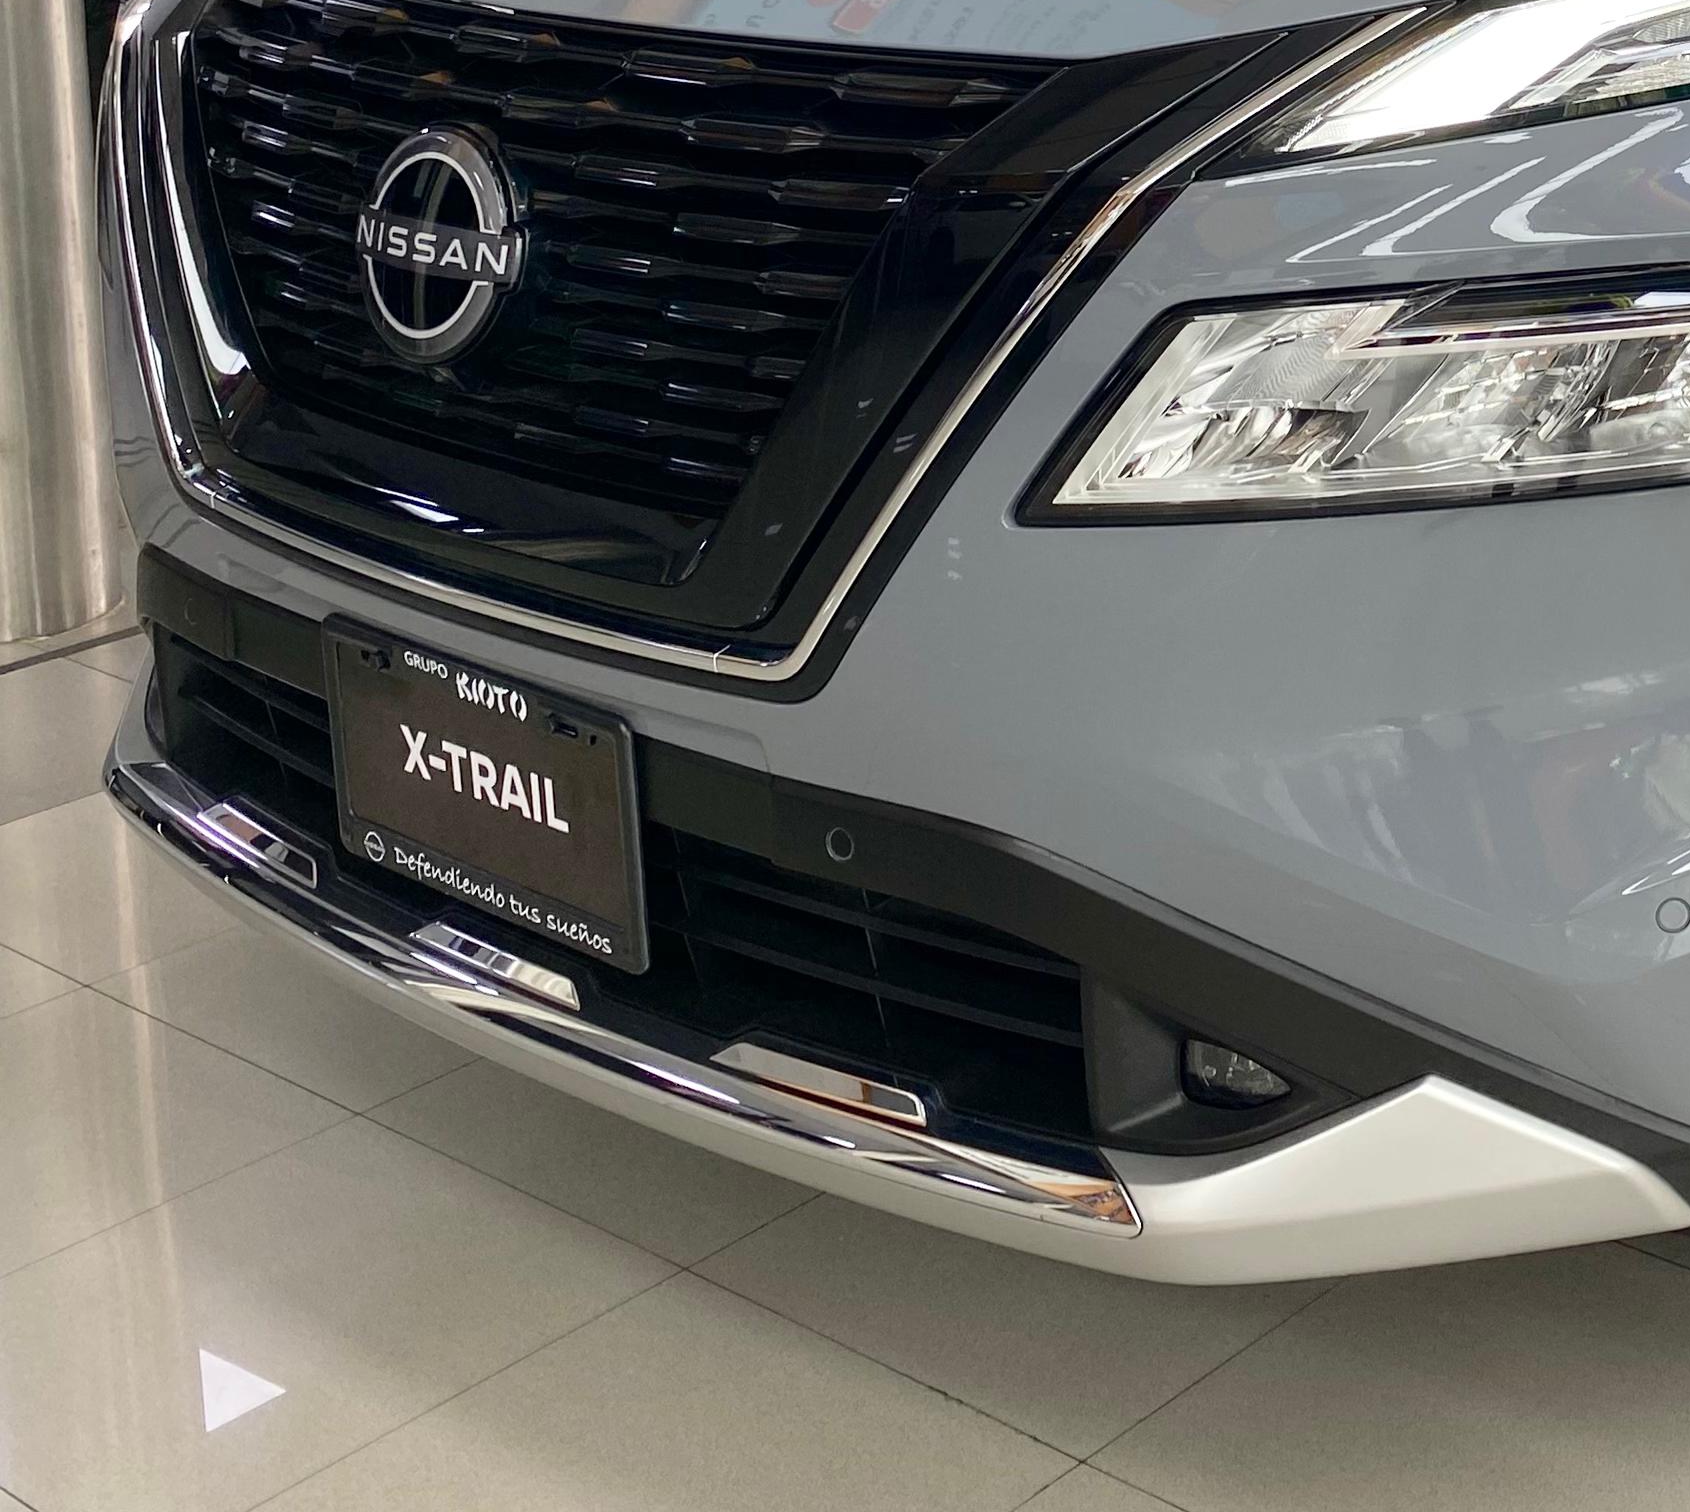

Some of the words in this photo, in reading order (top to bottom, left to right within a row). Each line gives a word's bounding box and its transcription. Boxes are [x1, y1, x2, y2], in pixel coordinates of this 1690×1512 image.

[356, 214, 509, 276] NISSAN
[403, 649, 449, 681] GRUPO
[454, 670, 528, 722] KIOTO
[399, 723, 570, 834] X-TRAIL
[393, 846, 505, 909] Defendiendo
[508, 893, 542, 925] tus
[546, 913, 613, 955] sueños
